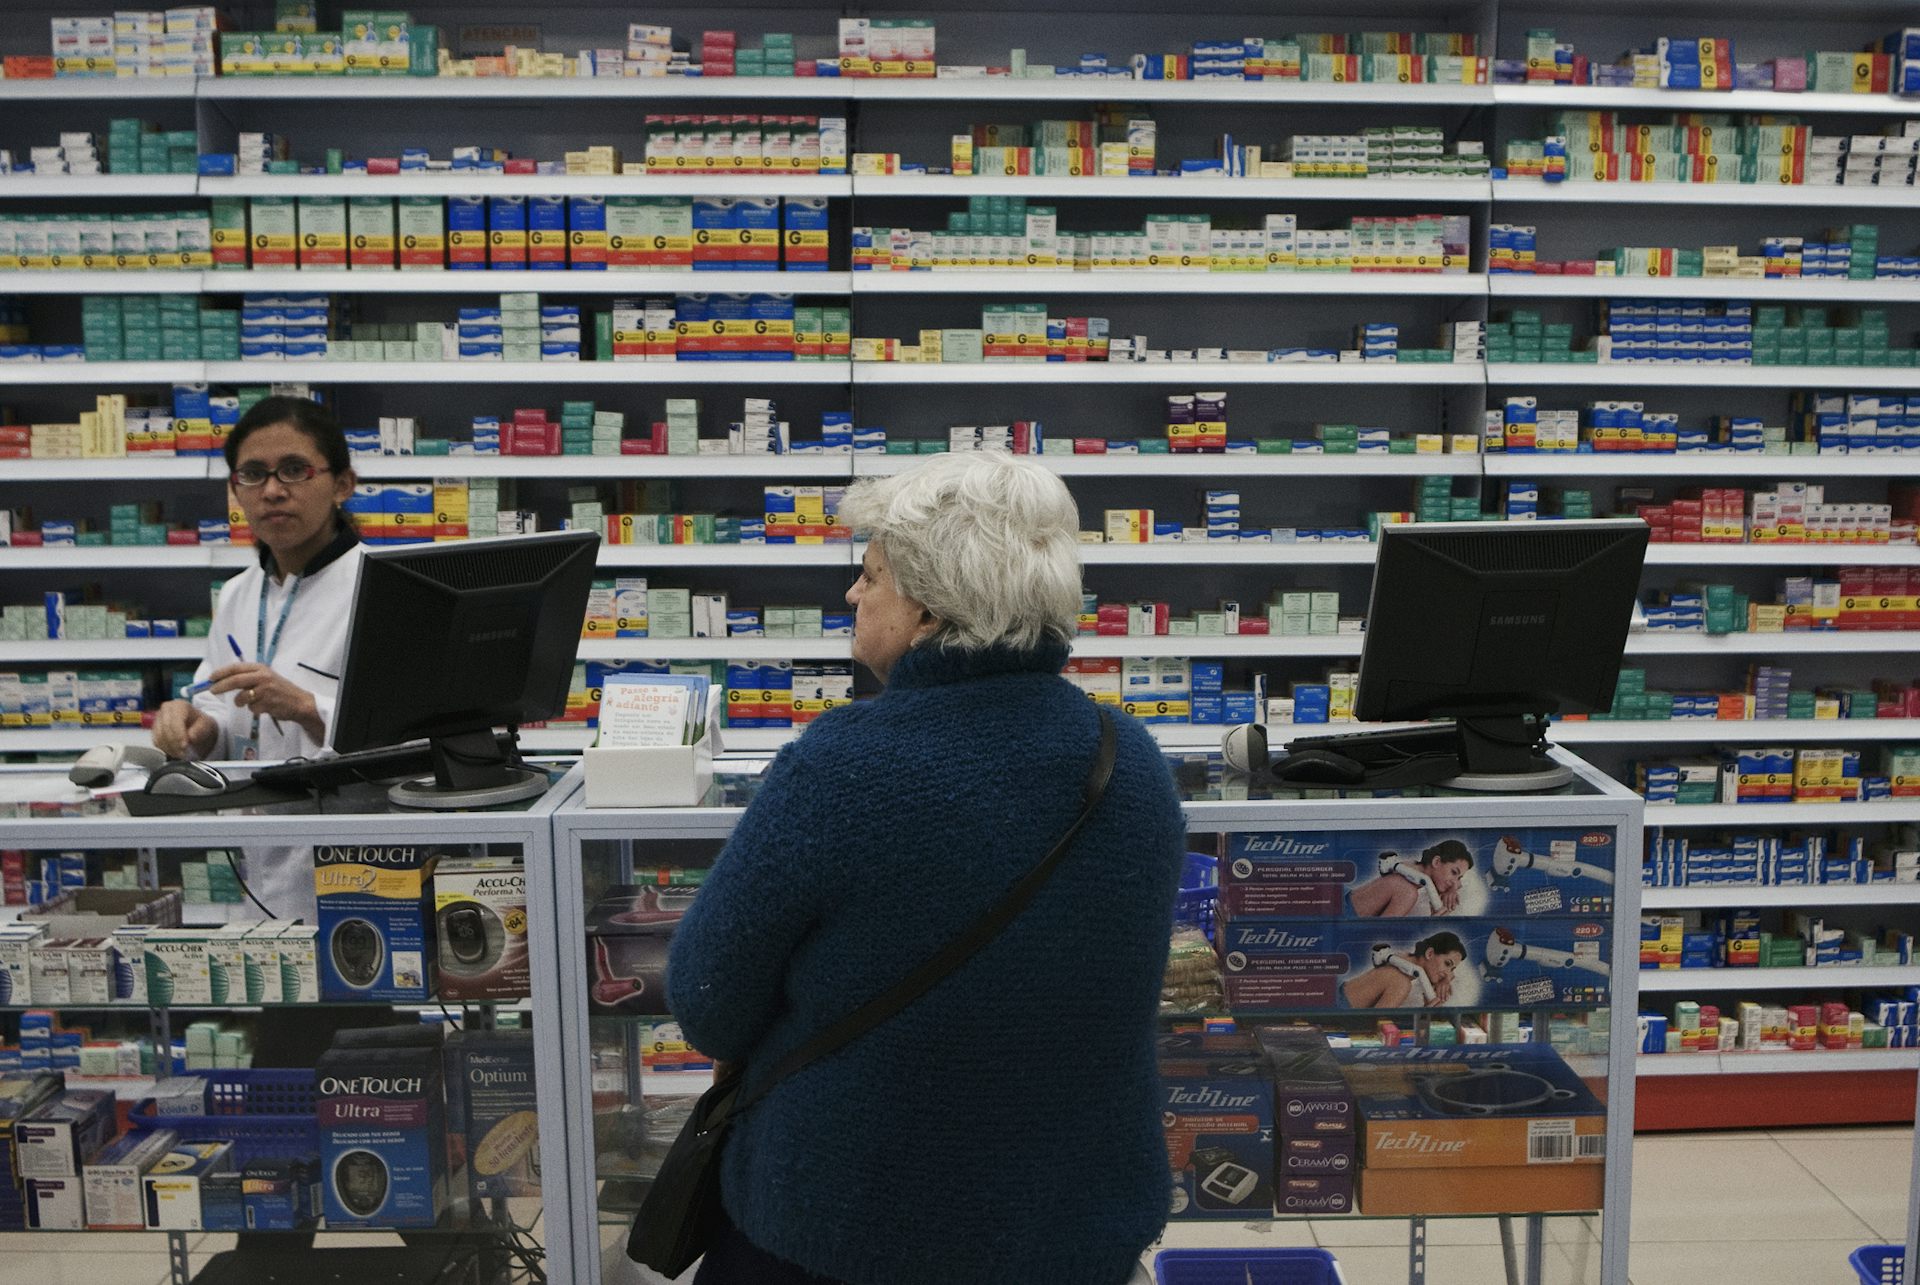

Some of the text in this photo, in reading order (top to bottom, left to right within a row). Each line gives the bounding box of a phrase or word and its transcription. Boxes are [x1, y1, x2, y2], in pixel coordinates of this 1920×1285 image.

[1701, 41, 1712, 53] G
[56, 57, 66, 68] G
[86, 57, 96, 68] G
[905, 61, 915, 72] G
[1703, 64, 1714, 77] G
[1856, 63, 1869, 77] G
[256, 234, 268, 248] G
[305, 233, 318, 247] G
[355, 235, 367, 248] G
[404, 235, 416, 248] G
[451, 232, 462, 244] G
[492, 231, 503, 244] G
[531, 231, 543, 244] G
[572, 231, 584, 245] G
[610, 234, 623, 249] G
[654, 234, 667, 249] G
[697, 229, 710, 244] G
[739, 229, 752, 243] G
[789, 230, 802, 245] G
[52, 254, 62, 266] G
[678, 322, 689, 334] G
[712, 319, 725, 334] G
[754, 319, 767, 334] G
[177, 419, 188, 432] G
[618, 617, 628, 628] G
[1489, 615, 1546, 625] SAMSUNG
[590, 688, 602, 701] G
[730, 689, 741, 702] G
[762, 690, 772, 701] G
[1125, 702, 1136, 715] G
[1157, 701, 1168, 713] G
[1242, 835, 1326, 855] TechLine
[473, 888, 513, 897] Performa
[1235, 928, 1319, 948] TechLine
[154, 943, 205, 953] ACCU-CHEK
[470, 1068, 528, 1086] Optium
[1168, 1086, 1257, 1107] TechLine
[335, 1103, 381, 1118] Ultra
[1372, 1131, 1467, 1152] TechLine
